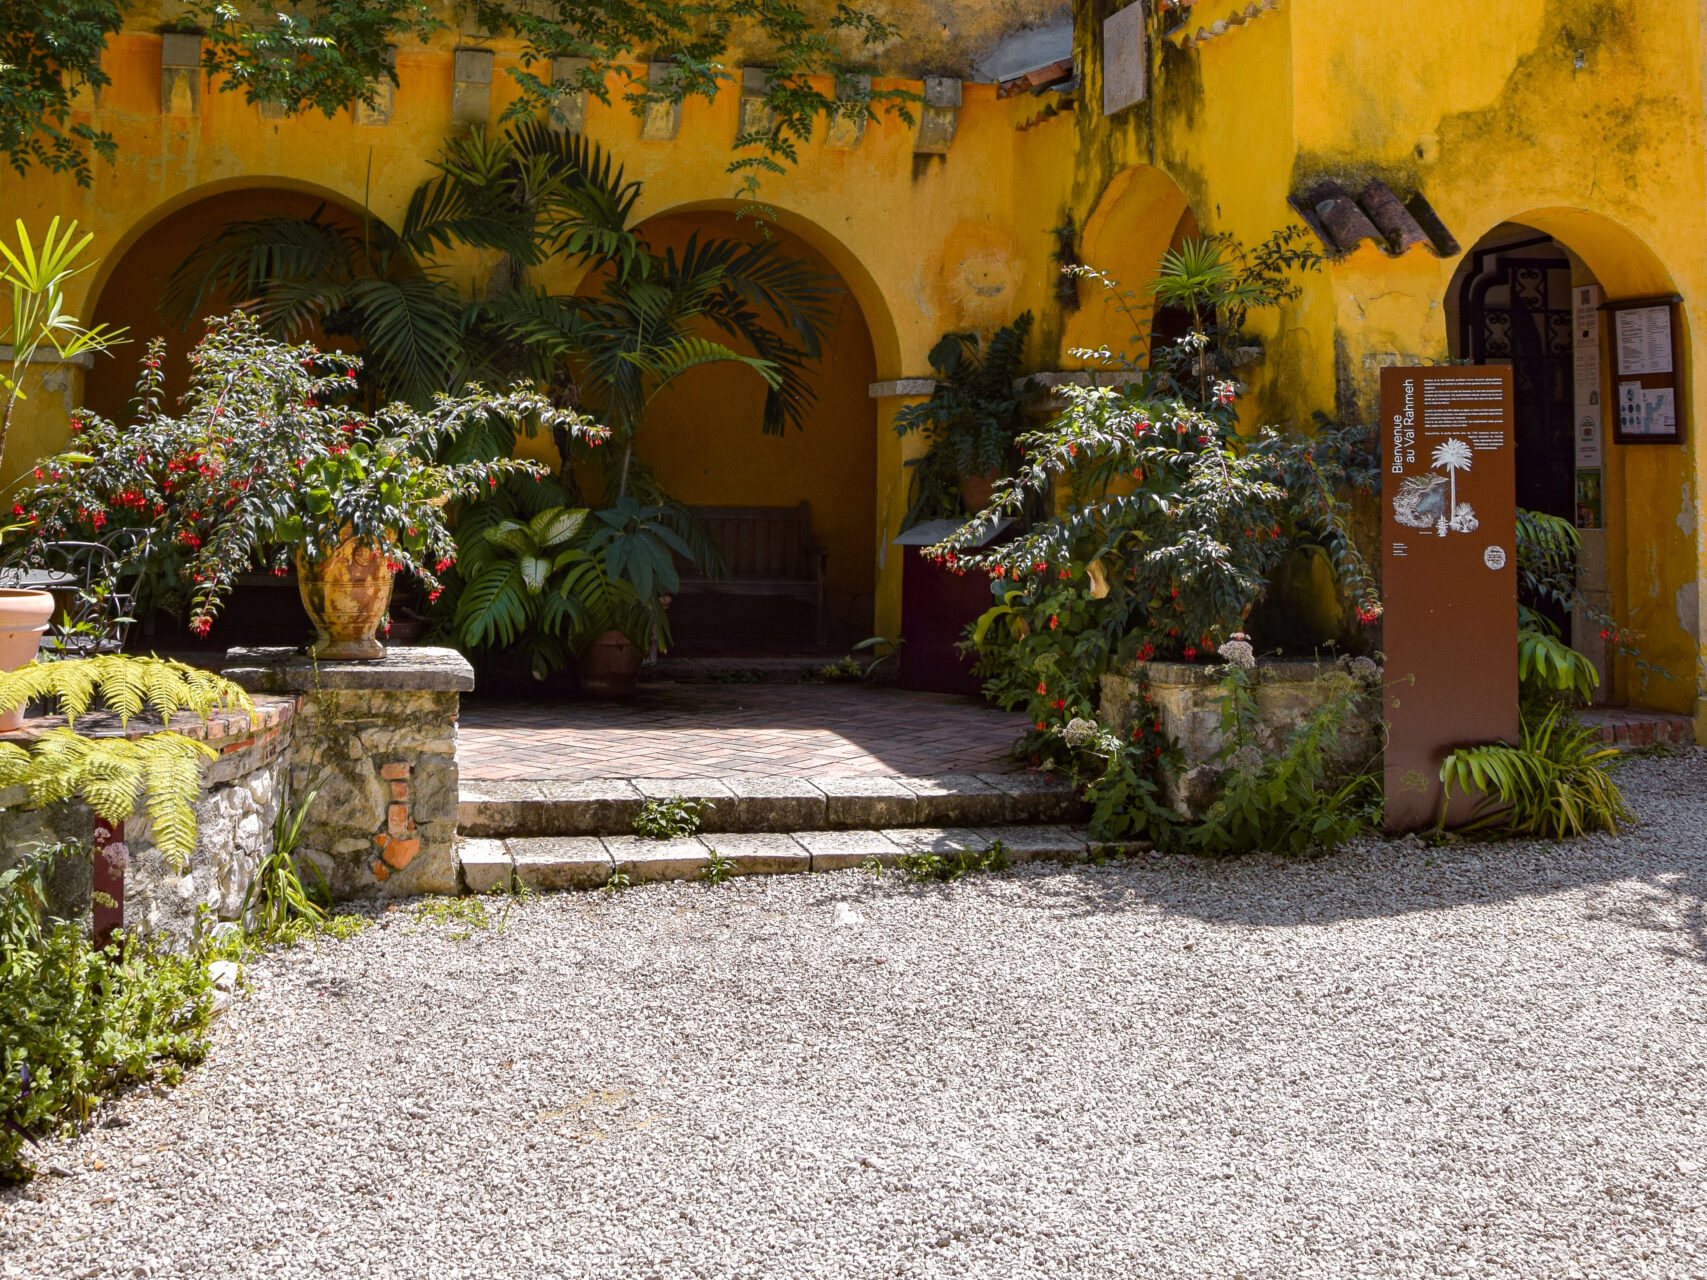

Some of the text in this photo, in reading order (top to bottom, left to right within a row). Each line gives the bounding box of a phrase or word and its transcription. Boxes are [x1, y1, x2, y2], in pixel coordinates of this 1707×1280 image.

[1391, 415, 1403, 473] Bienvenue
[1403, 379, 1415, 463] au Val Rahmeh
